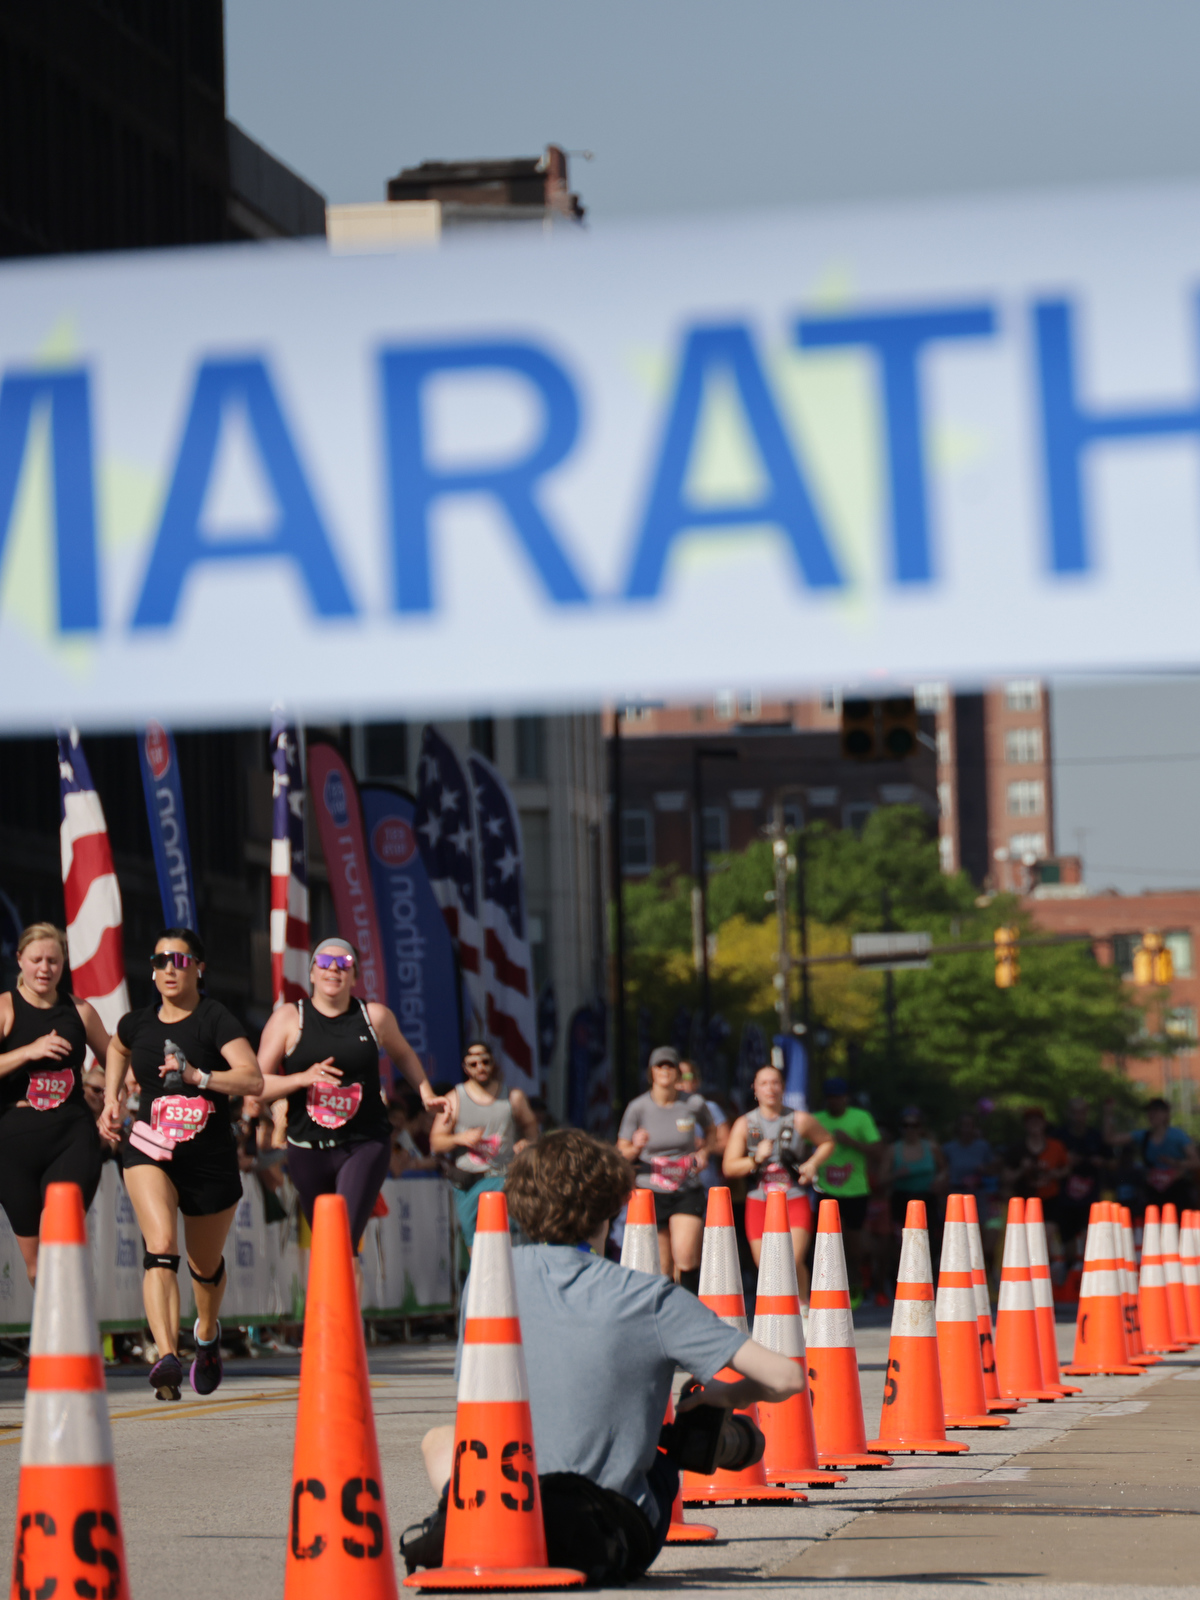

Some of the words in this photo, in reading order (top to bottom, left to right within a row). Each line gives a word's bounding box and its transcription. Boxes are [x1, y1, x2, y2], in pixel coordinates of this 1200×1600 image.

[36, 1078, 67, 1093] 5192
[319, 1095, 352, 1110] 5421
[165, 1106, 203, 1122] 5329
[453, 1439, 536, 1512] CS
[291, 1477, 385, 1560] CS
[14, 1510, 121, 1600] CS
